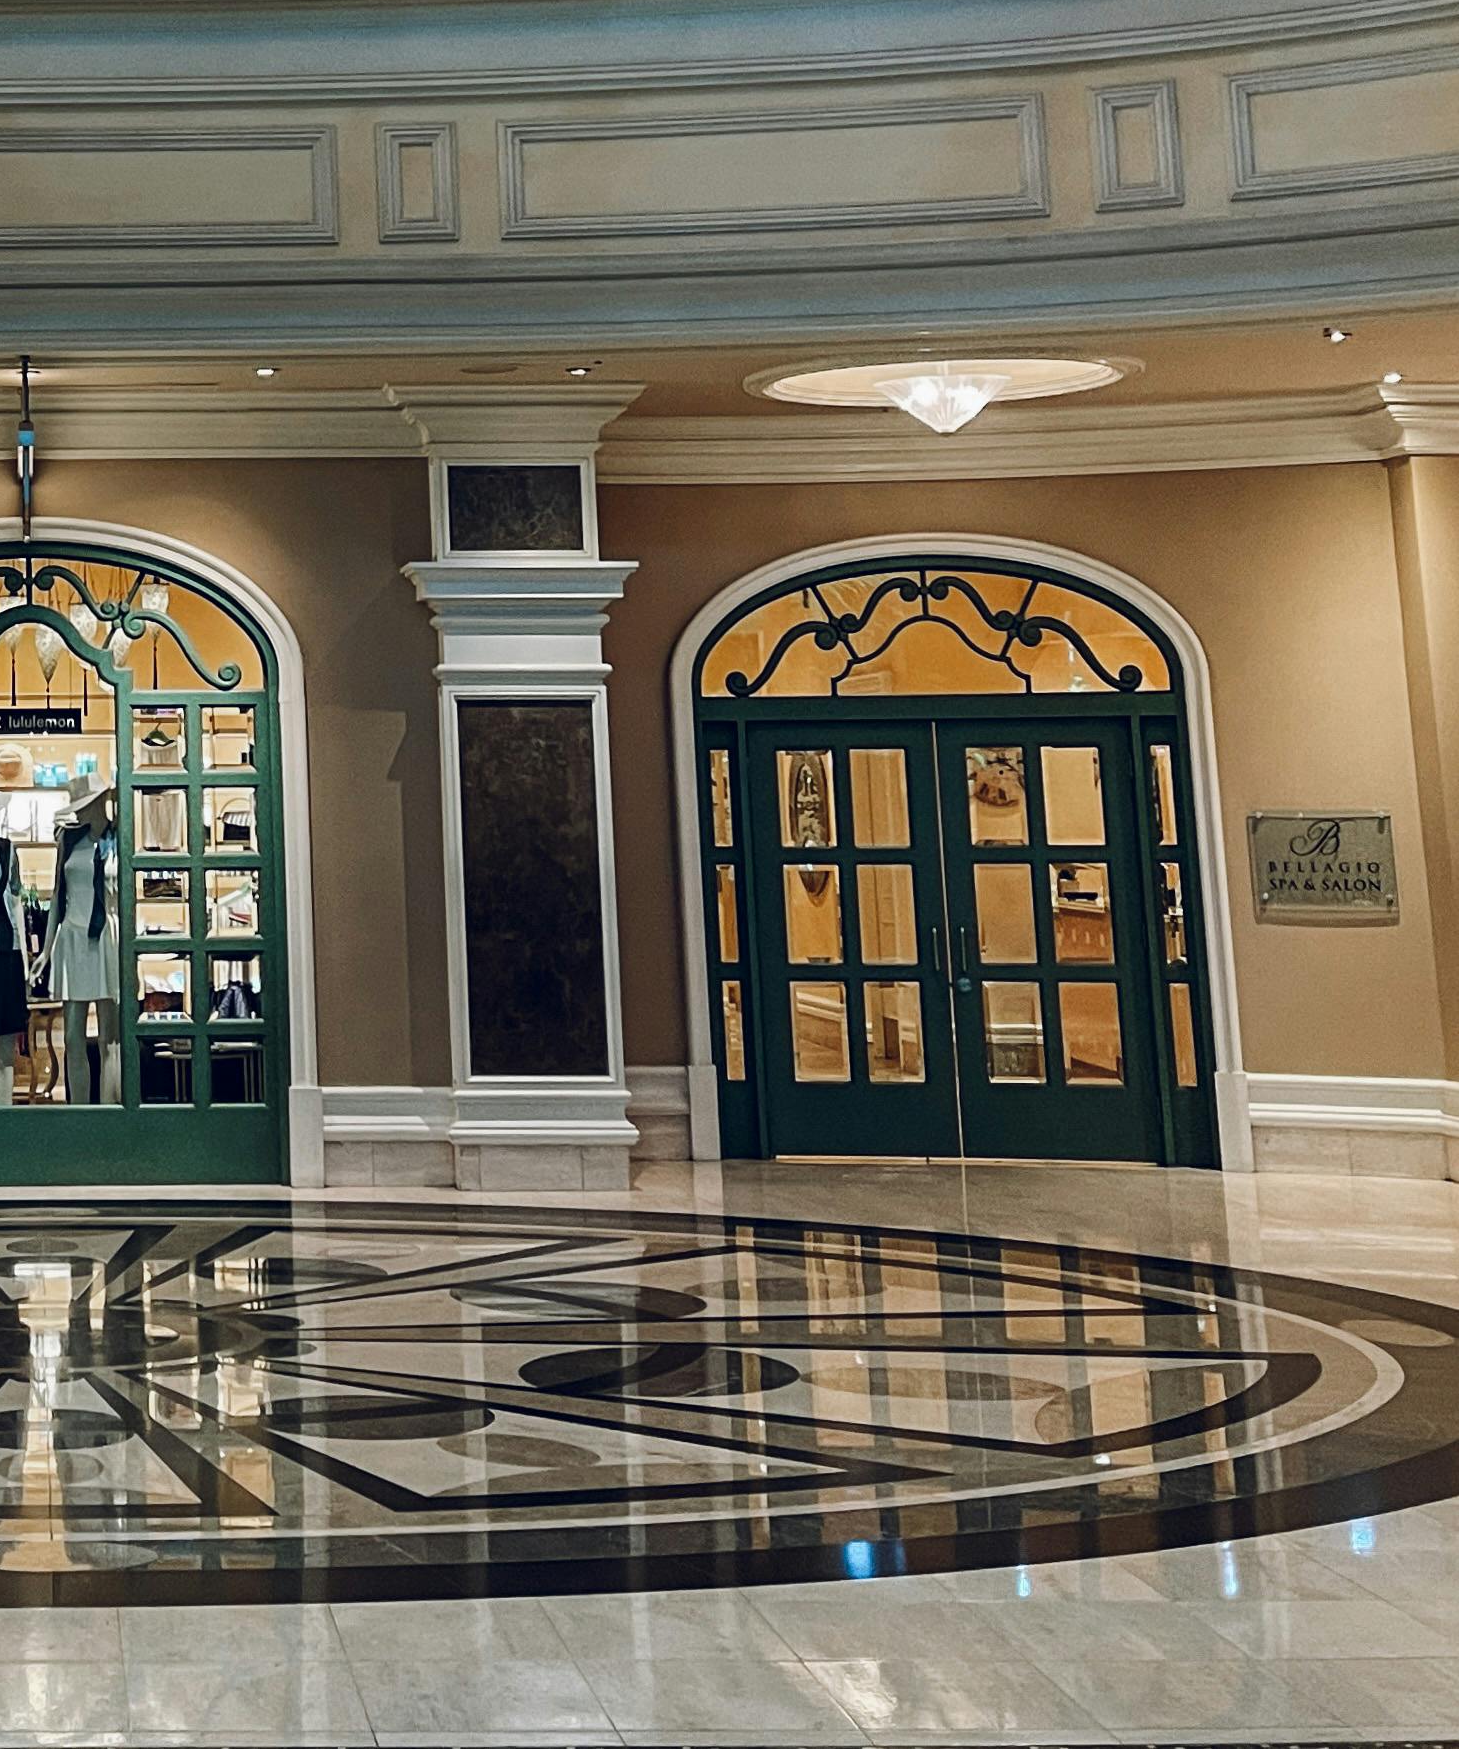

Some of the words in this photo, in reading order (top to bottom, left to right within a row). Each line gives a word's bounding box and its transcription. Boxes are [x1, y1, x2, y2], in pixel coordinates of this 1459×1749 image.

[8, 715, 75, 729] lululemon
[1268, 861, 1381, 874] BELLAGIO
[1269, 878, 1298, 891] SPA
[1303, 879, 1316, 891] &
[1322, 878, 1382, 891] SALON
